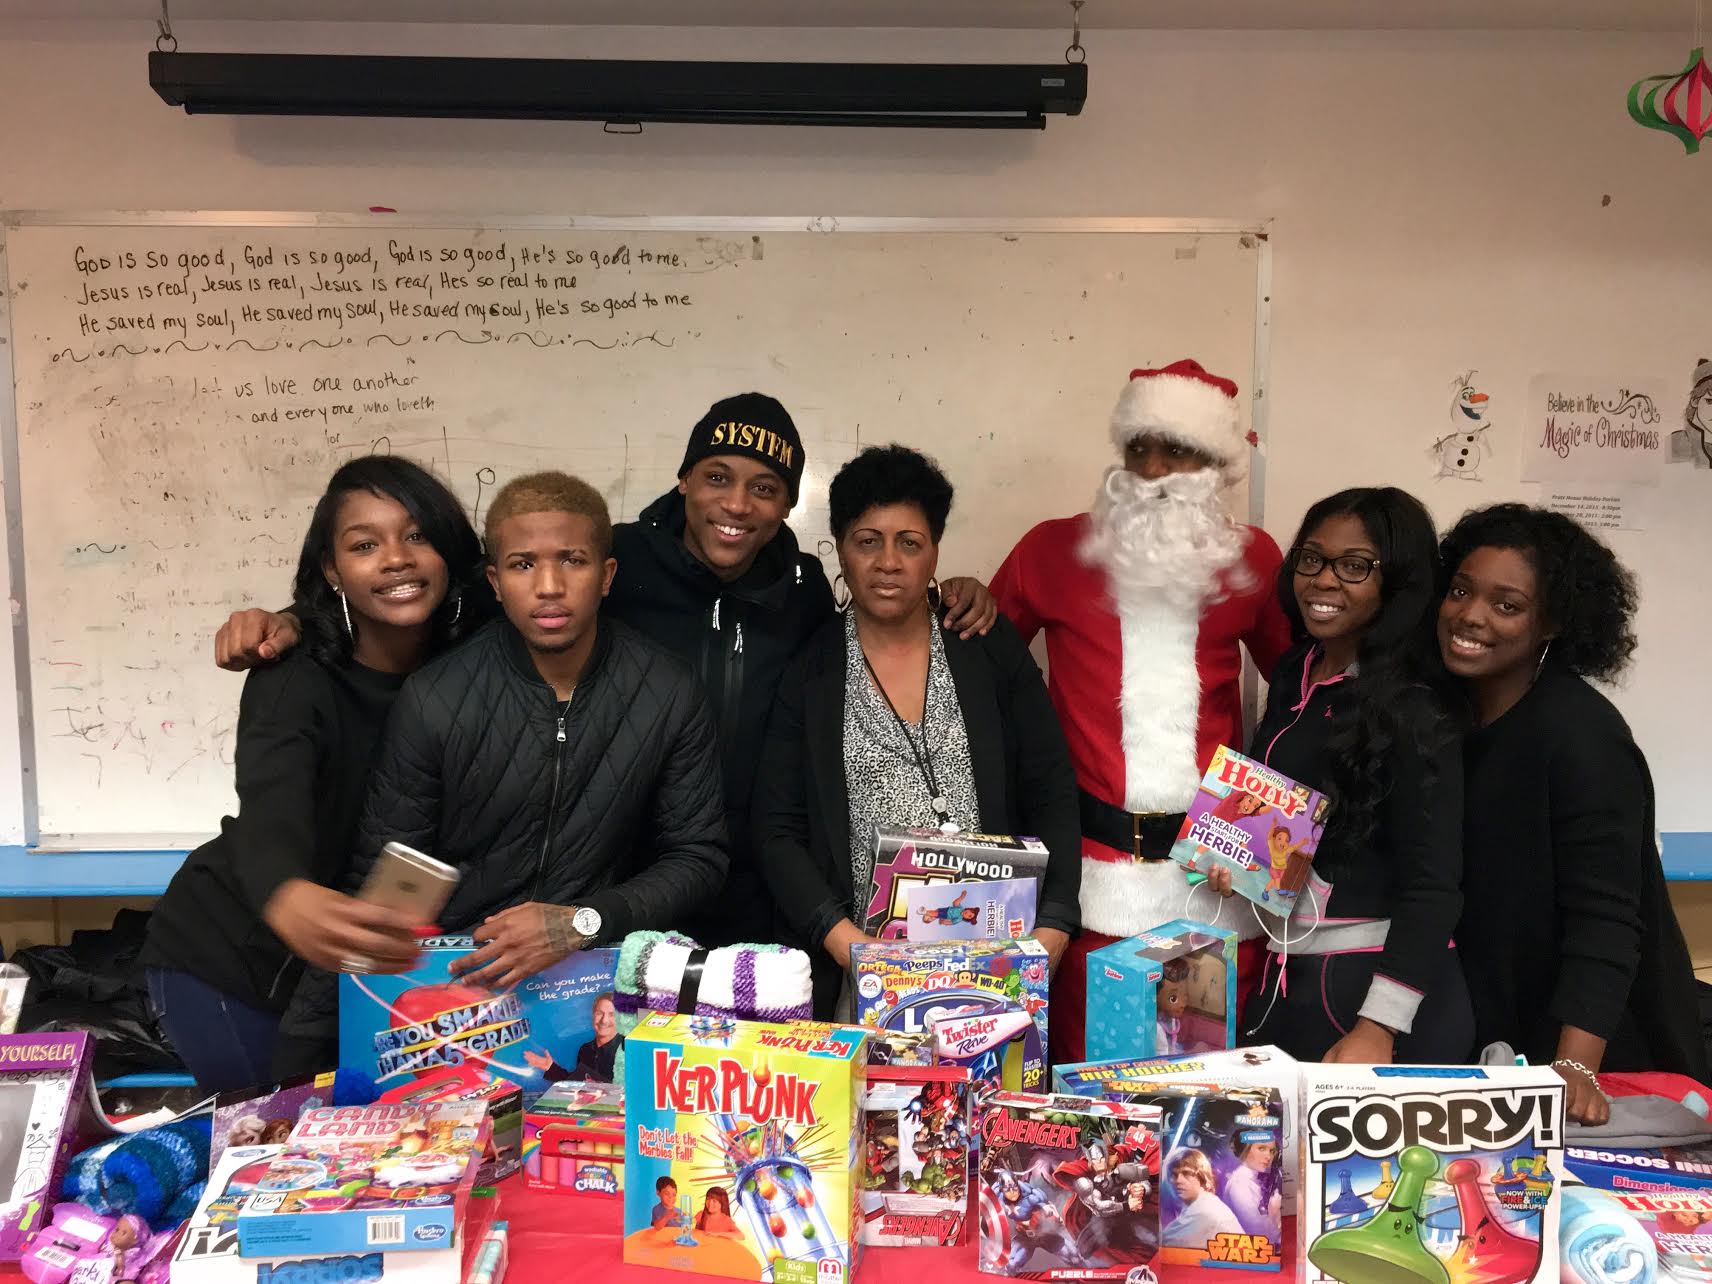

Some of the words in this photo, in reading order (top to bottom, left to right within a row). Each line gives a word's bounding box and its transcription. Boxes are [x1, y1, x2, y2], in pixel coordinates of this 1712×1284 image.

[178, 249, 234, 278] good,
[244, 245, 273, 268] God
[285, 254, 299, 265] is
[311, 251, 327, 264] so
[334, 248, 377, 273] good,
[389, 240, 415, 264] God
[420, 251, 432, 261] is
[440, 248, 458, 261] so
[464, 243, 515, 272] good,
[522, 245, 555, 265] He's
[566, 252, 583, 264] so
[639, 251, 654, 264] to
[77, 283, 129, 305] Jesus
[138, 285, 152, 298] is
[157, 278, 197, 304] real,
[202, 275, 242, 292] Jesus
[249, 278, 261, 290] is
[268, 275, 304, 299] real,
[310, 272, 363, 292] Jesus
[372, 278, 387, 291] is
[396, 273, 433, 300] real,
[476, 276, 494, 288] so
[500, 272, 528, 289] real
[535, 272, 547, 288] to
[554, 275, 577, 288] me
[80, 314, 100, 336] He
[107, 314, 155, 331] saved
[163, 318, 186, 338] my
[242, 305, 261, 322] He
[267, 302, 312, 321] saved
[318, 306, 342, 329] my
[347, 299, 384, 323] soul,
[390, 300, 414, 316] He
[416, 303, 459, 318] saved
[466, 305, 486, 325] my
[489, 302, 530, 324] soul,
[536, 298, 569, 320] He's
[581, 299, 600, 312] so
[603, 292, 637, 319] good
[643, 293, 658, 306] to
[665, 294, 691, 306] me
[235, 383, 253, 397] us
[313, 378, 342, 392] one
[353, 372, 419, 391] another
[252, 408, 278, 423] and
[363, 401, 389, 413] who
[1548, 392, 1574, 413] Believe
[1577, 396, 1584, 413] in
[1586, 394, 1599, 413] the
[711, 422, 793, 469] SYSTEM
[1540, 415, 1581, 459] Magic
[1583, 423, 1593, 443] of
[1596, 417, 1659, 450] Christmas
[1218, 758, 1305, 817] HOLLY
[1255, 767, 1286, 788] Healthy
[1200, 814, 1209, 825] A
[1211, 818, 1252, 843] HEALTHY
[1211, 827, 1227, 839] START
[1228, 835, 1240, 844] FOR
[1190, 826, 1252, 868] HERBIE!
[911, 852, 1013, 878] HOLLYWOOD
[987, 901, 995, 936] HERBIE!
[859, 963, 903, 975] ORTEGA
[905, 960, 942, 971] Peeps
[944, 958, 986, 971] FedEx
[526, 982, 549, 991] Can
[554, 977, 576, 992] you
[580, 972, 611, 982] make
[863, 980, 878, 988] EA
[886, 976, 922, 987] Denny's
[928, 976, 951, 990] DQ
[980, 977, 1004, 989] WD-40
[539, 990, 558, 1001] the
[561, 984, 601, 1001] grade?
[394, 1023, 433, 1047] YOU
[943, 1019, 997, 1045] Twister
[0, 1044, 75, 1062] YOURSELF!
[957, 1035, 988, 1055] Rave
[1080, 1070, 1115, 1082] AIR
[1121, 1062, 1205, 1076] HOCKEY
[307, 1103, 441, 1125] CANDY
[1235, 1116, 1278, 1126] PANORAMA
[1317, 1094, 1553, 1154] SORRY!
[297, 1120, 401, 1137] LAND
[639, 1125, 664, 1144] Don't
[665, 1129, 681, 1146] Let
[683, 1134, 697, 1146] the
[982, 1109, 1080, 1149] AVENGERS
[1133, 1132, 1143, 1143] 48
[639, 1142, 672, 1159] Marbles
[675, 1147, 693, 1161] Fall!
[1567, 1148, 1670, 1169] SOCCER
[576, 1178, 615, 1193] CHALK
[878, 1210, 961, 1246] AVENGERS
[1215, 1233, 1267, 1248] STAR
[1208, 1247, 1274, 1262] WARS
